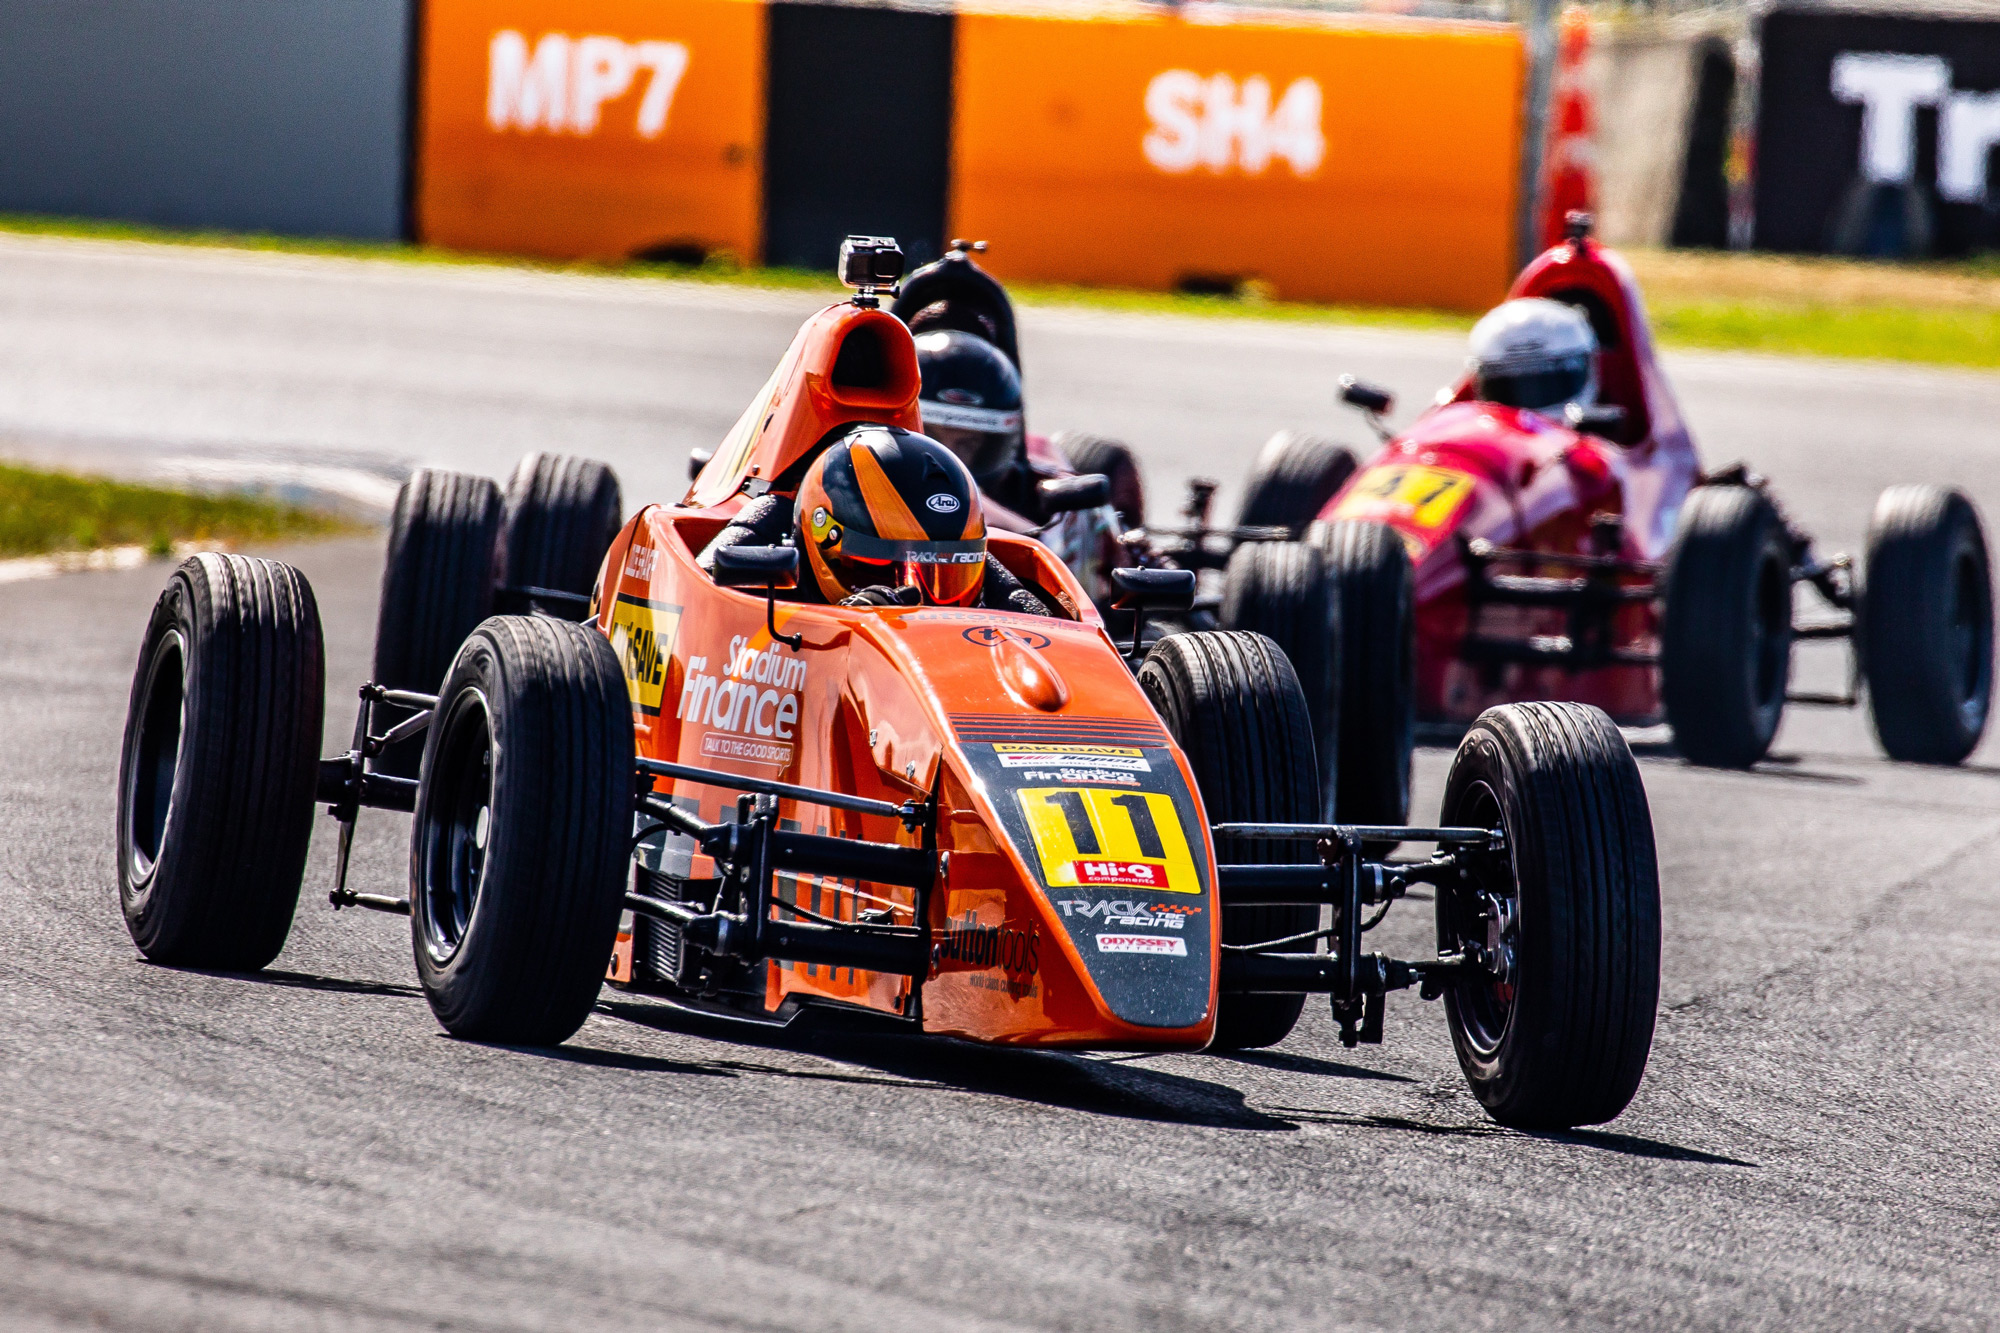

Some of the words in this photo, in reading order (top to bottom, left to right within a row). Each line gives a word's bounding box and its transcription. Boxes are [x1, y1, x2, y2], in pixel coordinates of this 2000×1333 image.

[489, 30, 690, 137] MP7
[1142, 70, 1326, 177] SH4
[905, 550, 937, 563] TRACK
[723, 634, 807, 692] Stadium
[677, 655, 798, 739] Finance
[704, 738, 719, 752] TALK
[720, 740, 731, 754] TO
[730, 741, 744, 755] THE
[743, 743, 767, 759] GOOD
[766, 746, 791, 761] SPORTS
[1023, 771, 1137, 783] Finance
[1060, 767, 1135, 779] Stadium
[1044, 791, 1167, 859] 11
[1088, 876, 1155, 884] components
[1057, 899, 1154, 918] TRACK
[1100, 937, 1177, 947] ODYSSEY
